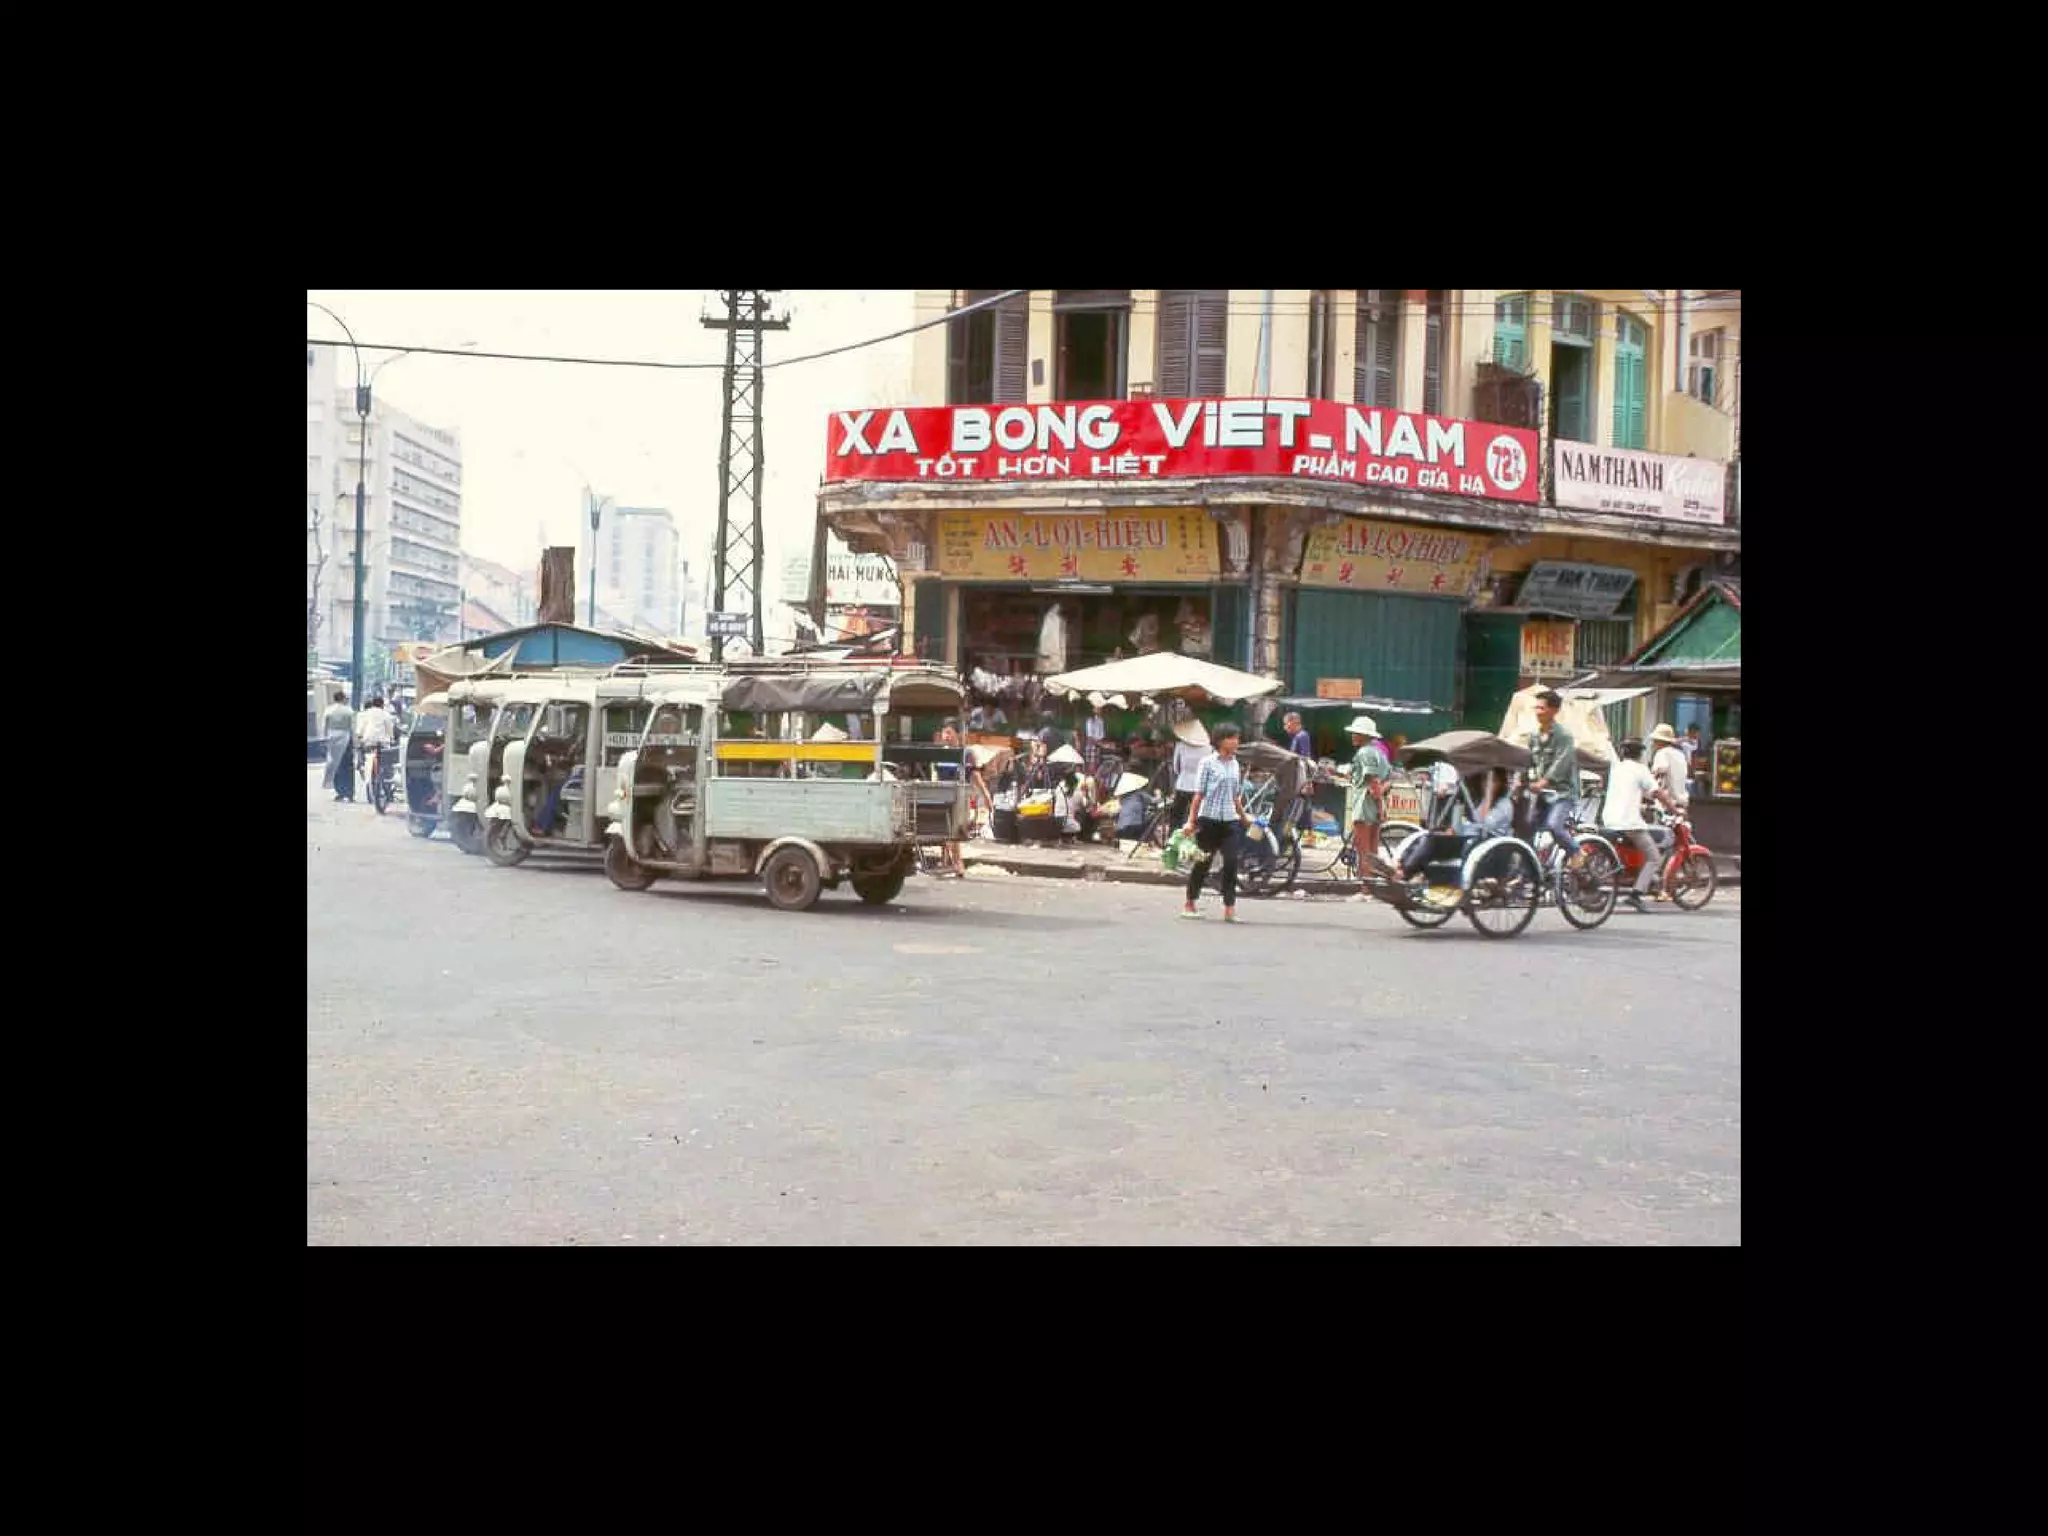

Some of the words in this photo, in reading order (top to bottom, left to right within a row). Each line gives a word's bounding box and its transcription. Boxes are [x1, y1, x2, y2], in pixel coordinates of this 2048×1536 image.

[836, 410, 919, 456] XA
[952, 405, 1121, 453] BONG
[1366, 461, 1409, 485] CAO
